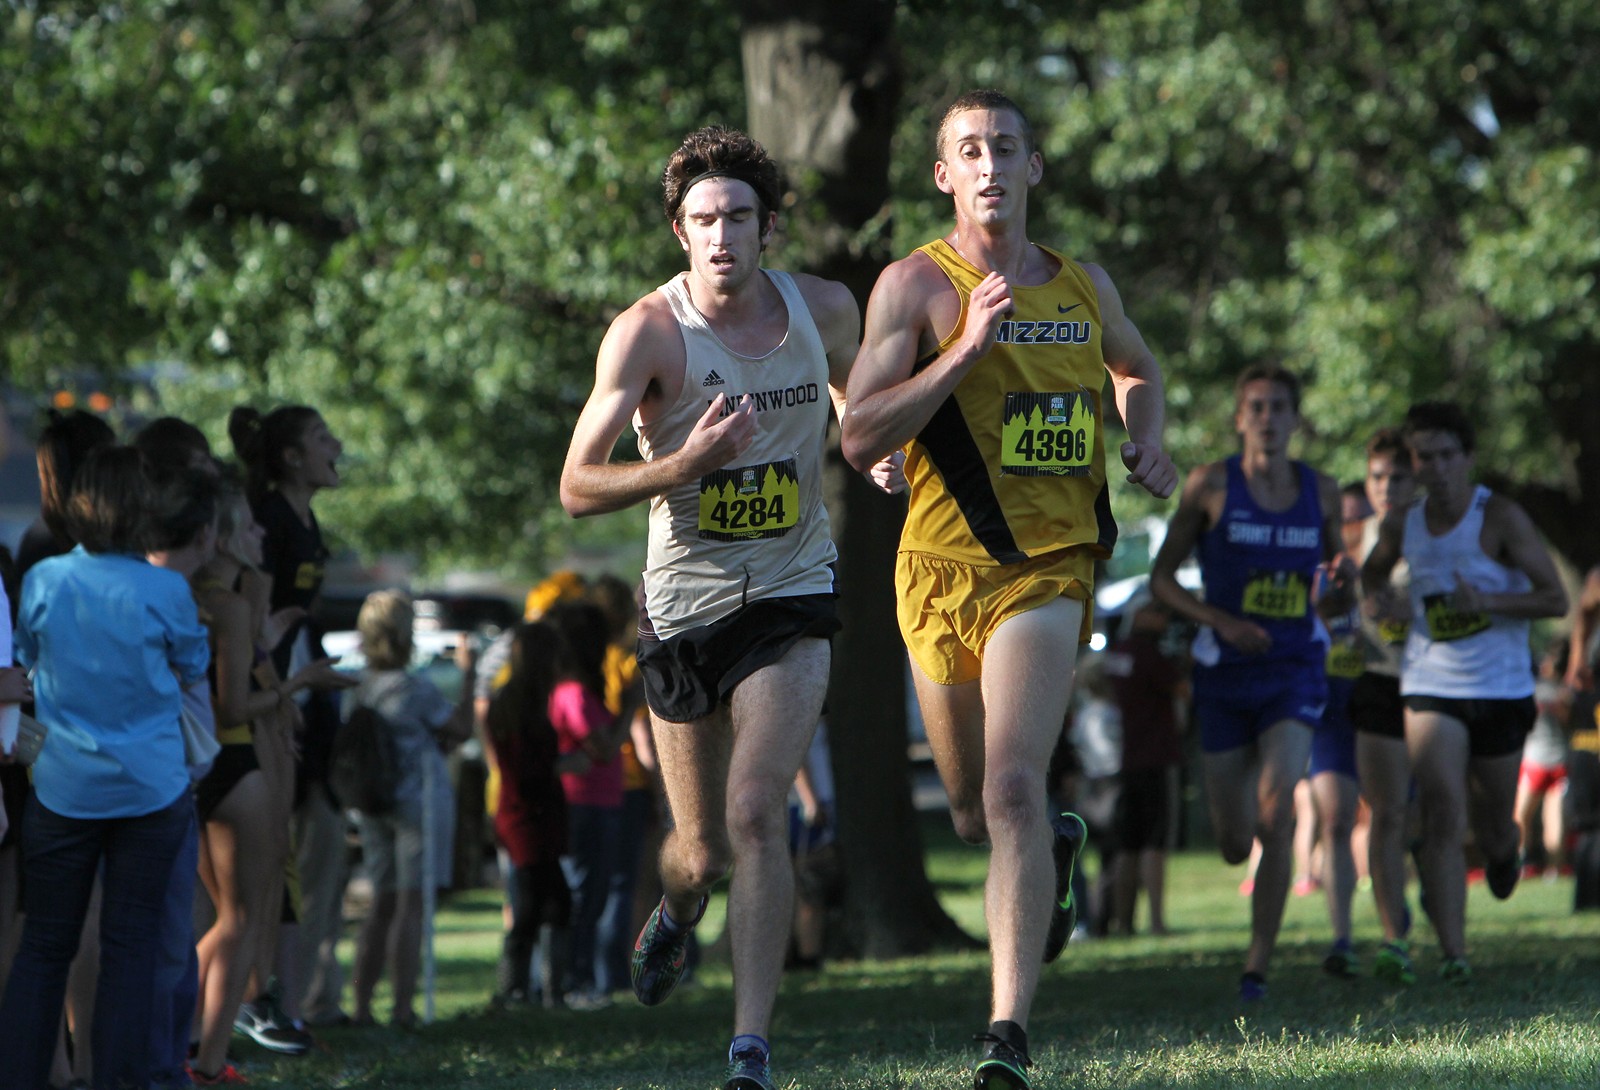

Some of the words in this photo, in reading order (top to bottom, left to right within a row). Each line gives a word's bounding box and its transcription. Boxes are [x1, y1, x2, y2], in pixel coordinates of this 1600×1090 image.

[995, 320, 1091, 344] MIZZOU
[702, 378, 725, 387] adidas
[708, 382, 819, 417] NNWOOD
[1015, 428, 1086, 462] 4396
[710, 494, 785, 529] 4284
[1228, 522, 1272, 545] SAINT
[1275, 526, 1320, 548] LOUIS
